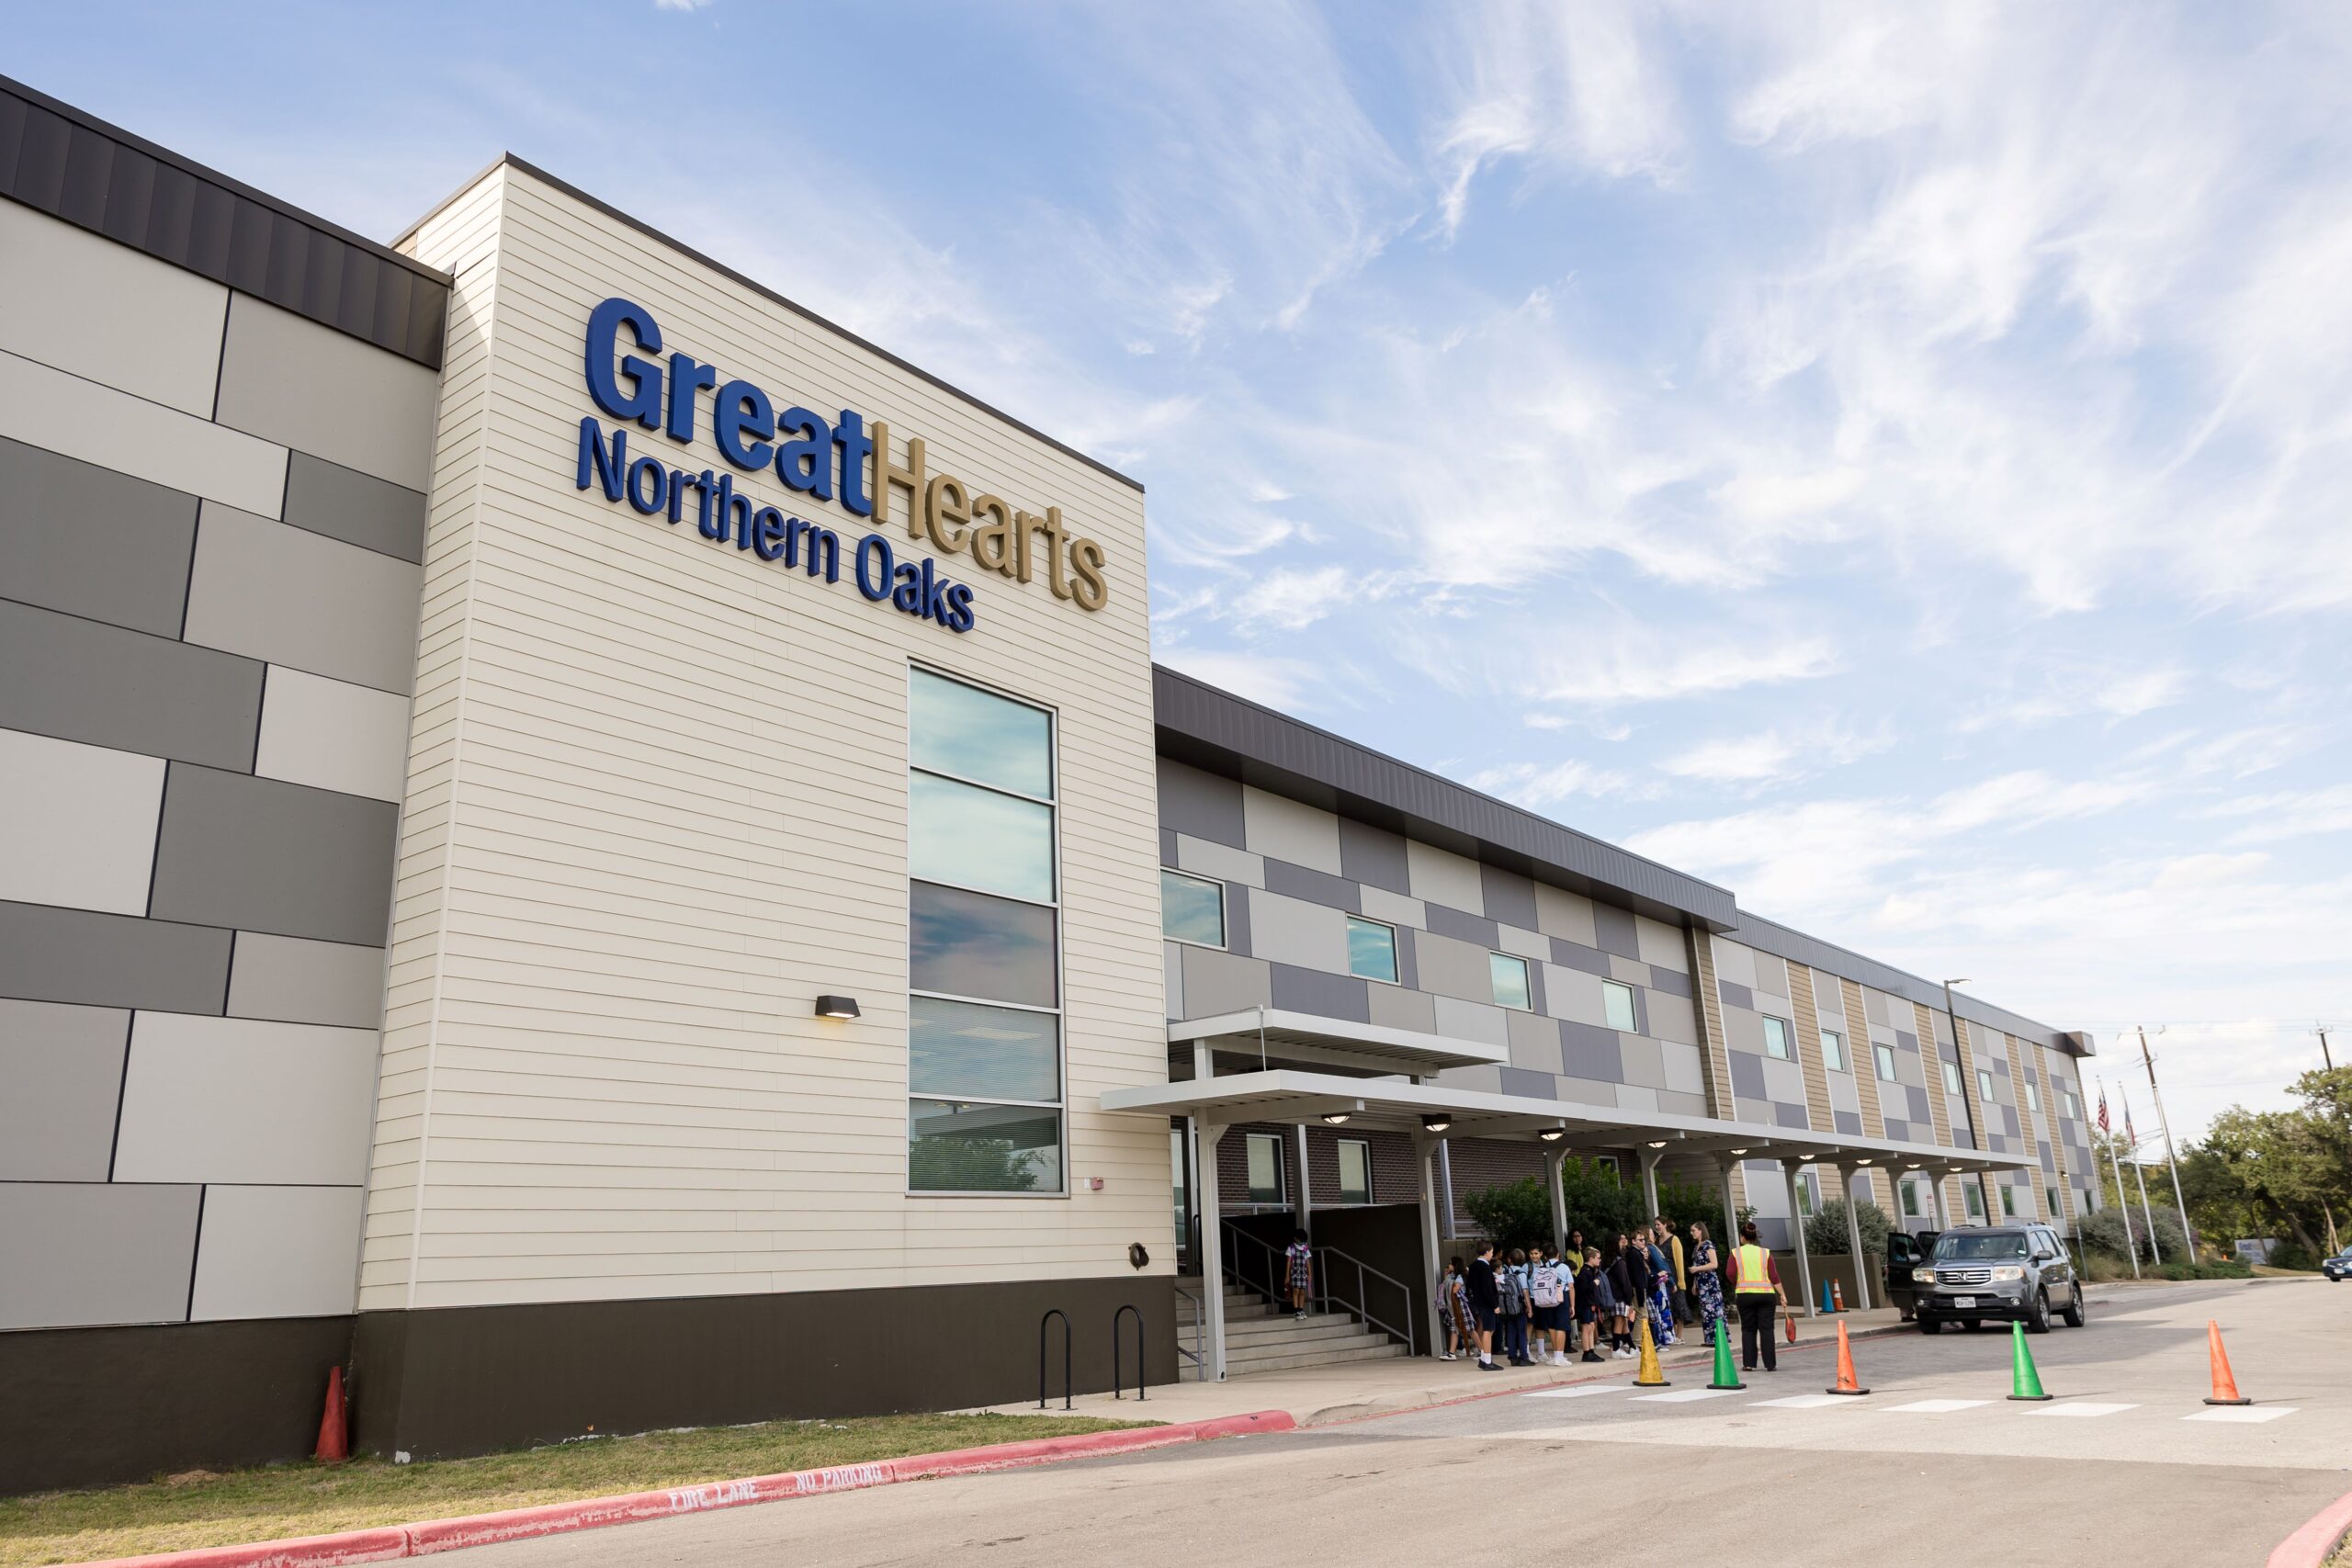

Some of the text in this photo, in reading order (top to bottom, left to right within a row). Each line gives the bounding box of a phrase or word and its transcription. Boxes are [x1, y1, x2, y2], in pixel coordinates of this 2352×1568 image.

[576, 416, 975, 633] Northern Oaks
[668, 1464, 883, 1511] FIRE LANE NO PARKING
